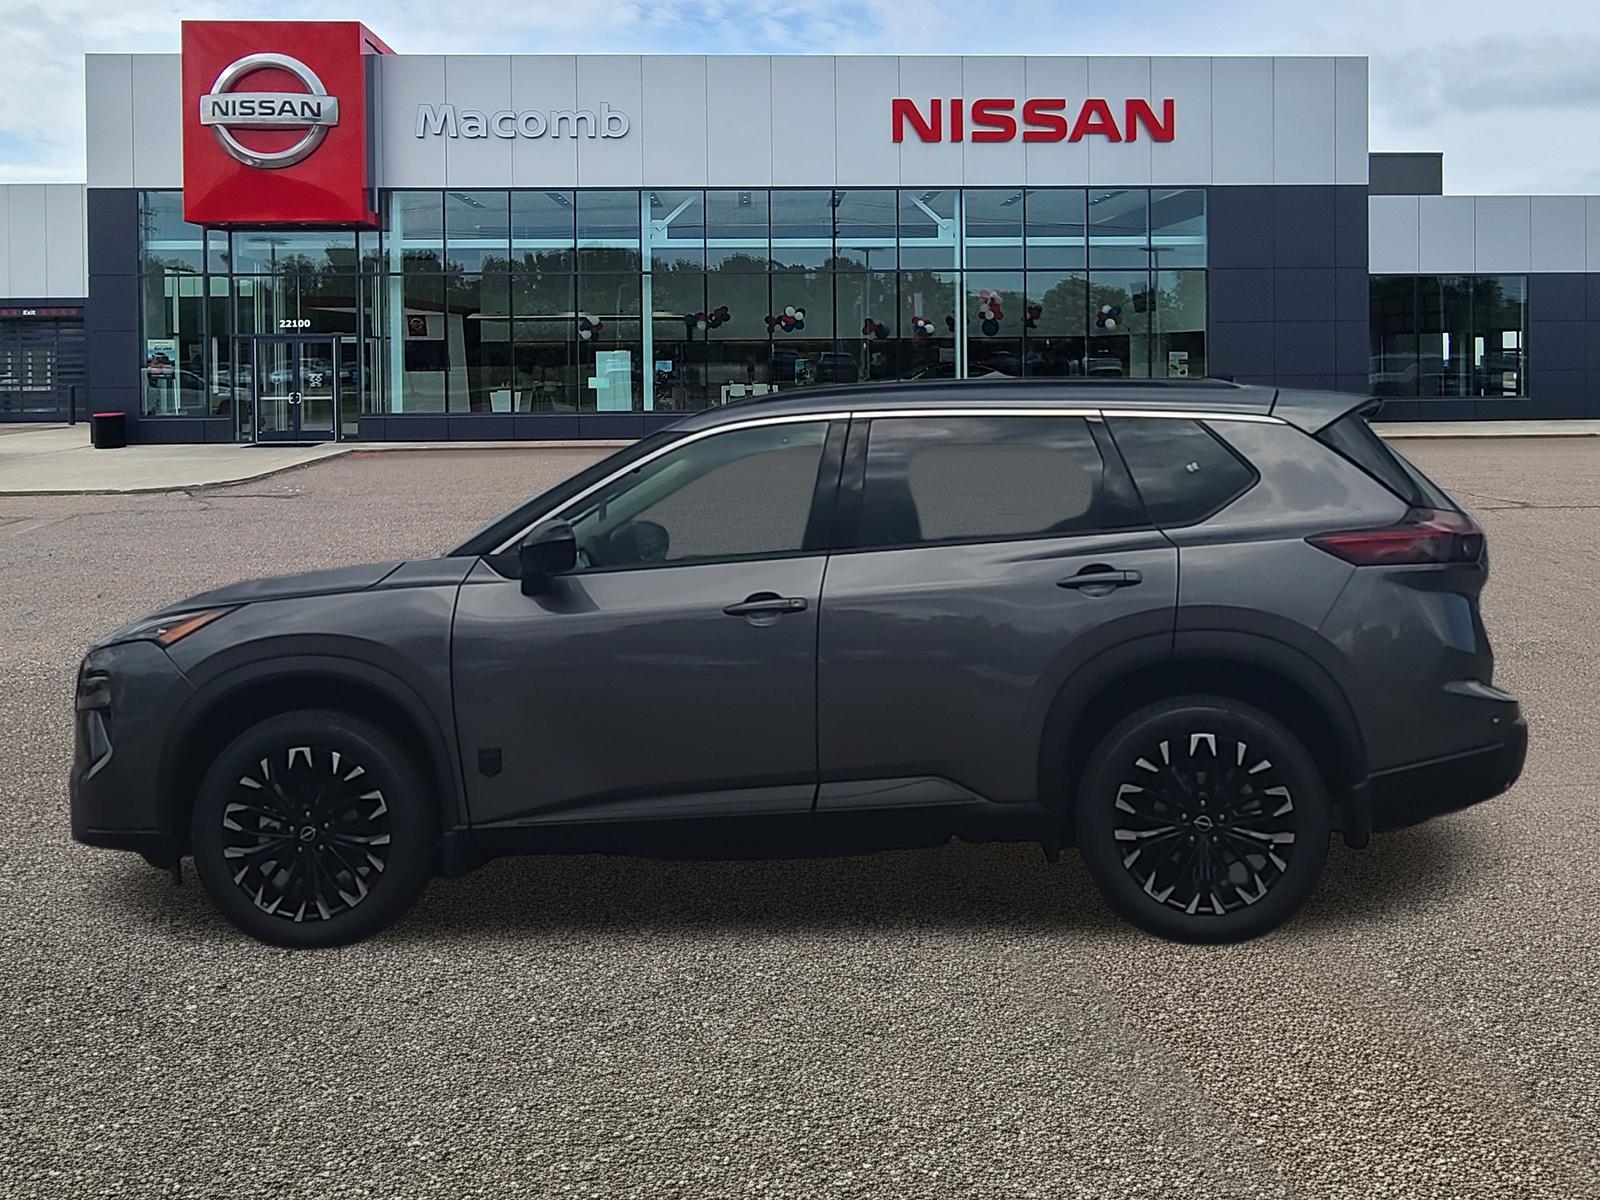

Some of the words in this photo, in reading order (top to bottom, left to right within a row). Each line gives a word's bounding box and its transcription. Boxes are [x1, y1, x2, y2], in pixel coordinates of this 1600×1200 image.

[211, 100, 322, 118] NISSAN
[415, 102, 630, 139] Macomb
[892, 98, 1175, 143] NISSAN
[279, 319, 311, 328] 22100
